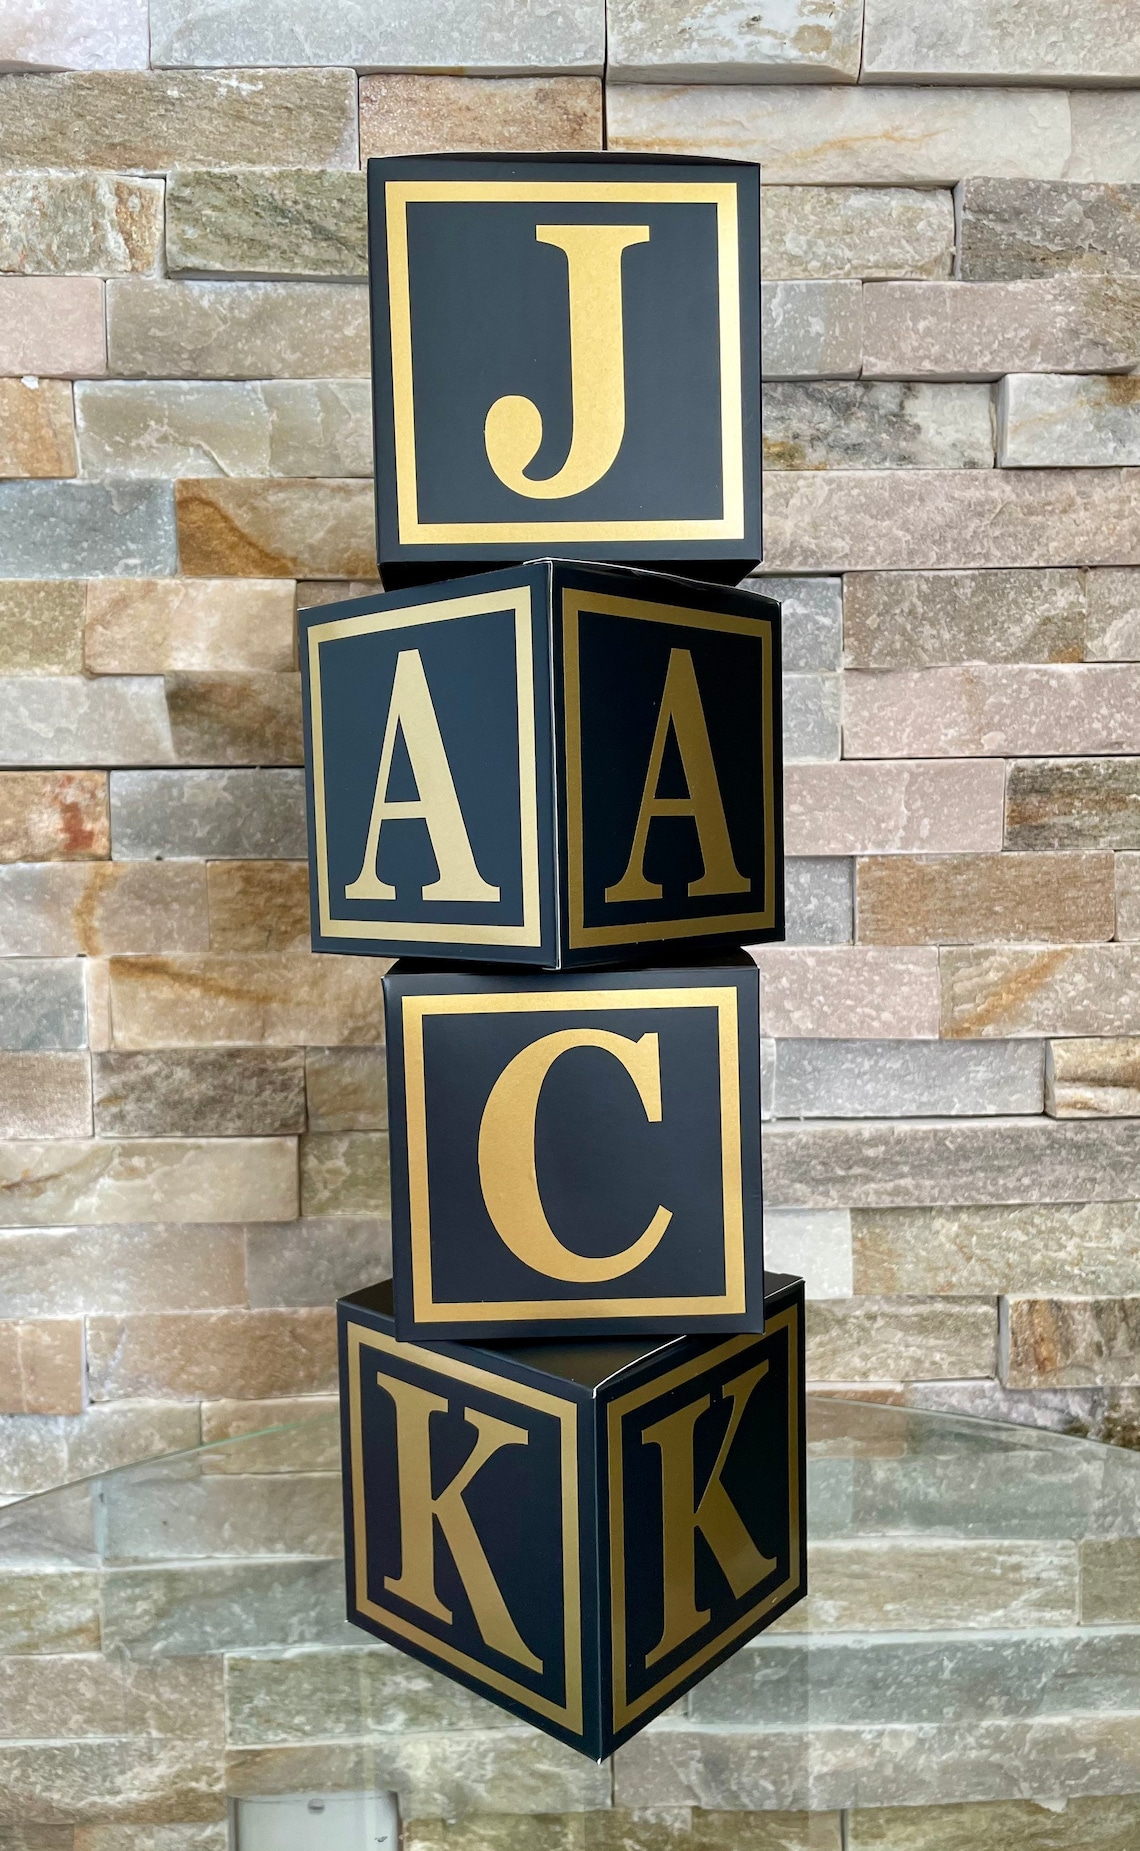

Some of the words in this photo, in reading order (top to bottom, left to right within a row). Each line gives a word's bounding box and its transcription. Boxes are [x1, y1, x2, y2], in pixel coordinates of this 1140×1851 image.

[485, 224, 650, 499] J
[346, 650, 499, 901] A
[605, 648, 750, 902] A
[478, 1029, 672, 1283] C
[376, 1373, 543, 1673] K
[642, 1361, 776, 1667] K
